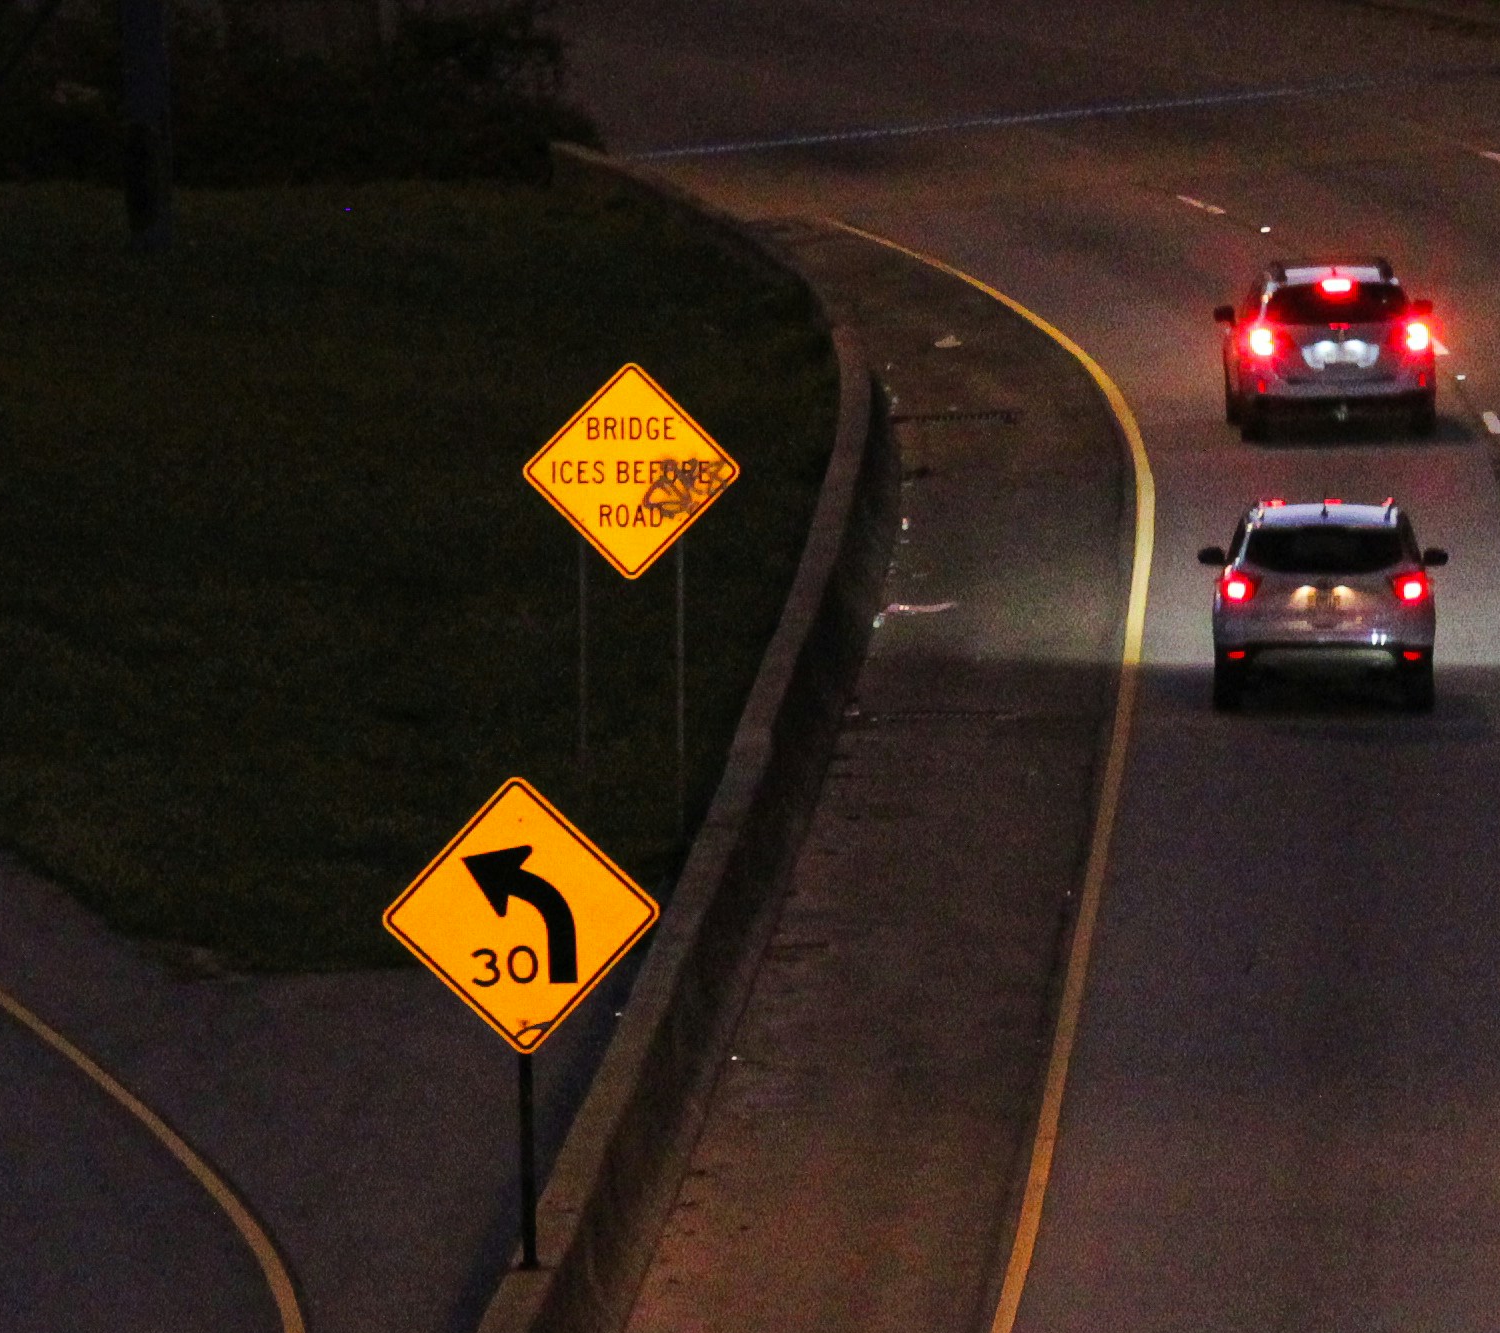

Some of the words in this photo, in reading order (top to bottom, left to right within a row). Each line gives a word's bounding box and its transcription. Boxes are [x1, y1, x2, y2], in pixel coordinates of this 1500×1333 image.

[586, 416, 676, 440] BRIDGE
[551, 460, 606, 484] ICES
[598, 504, 664, 528] ROAD
[470, 945, 539, 988] 30
